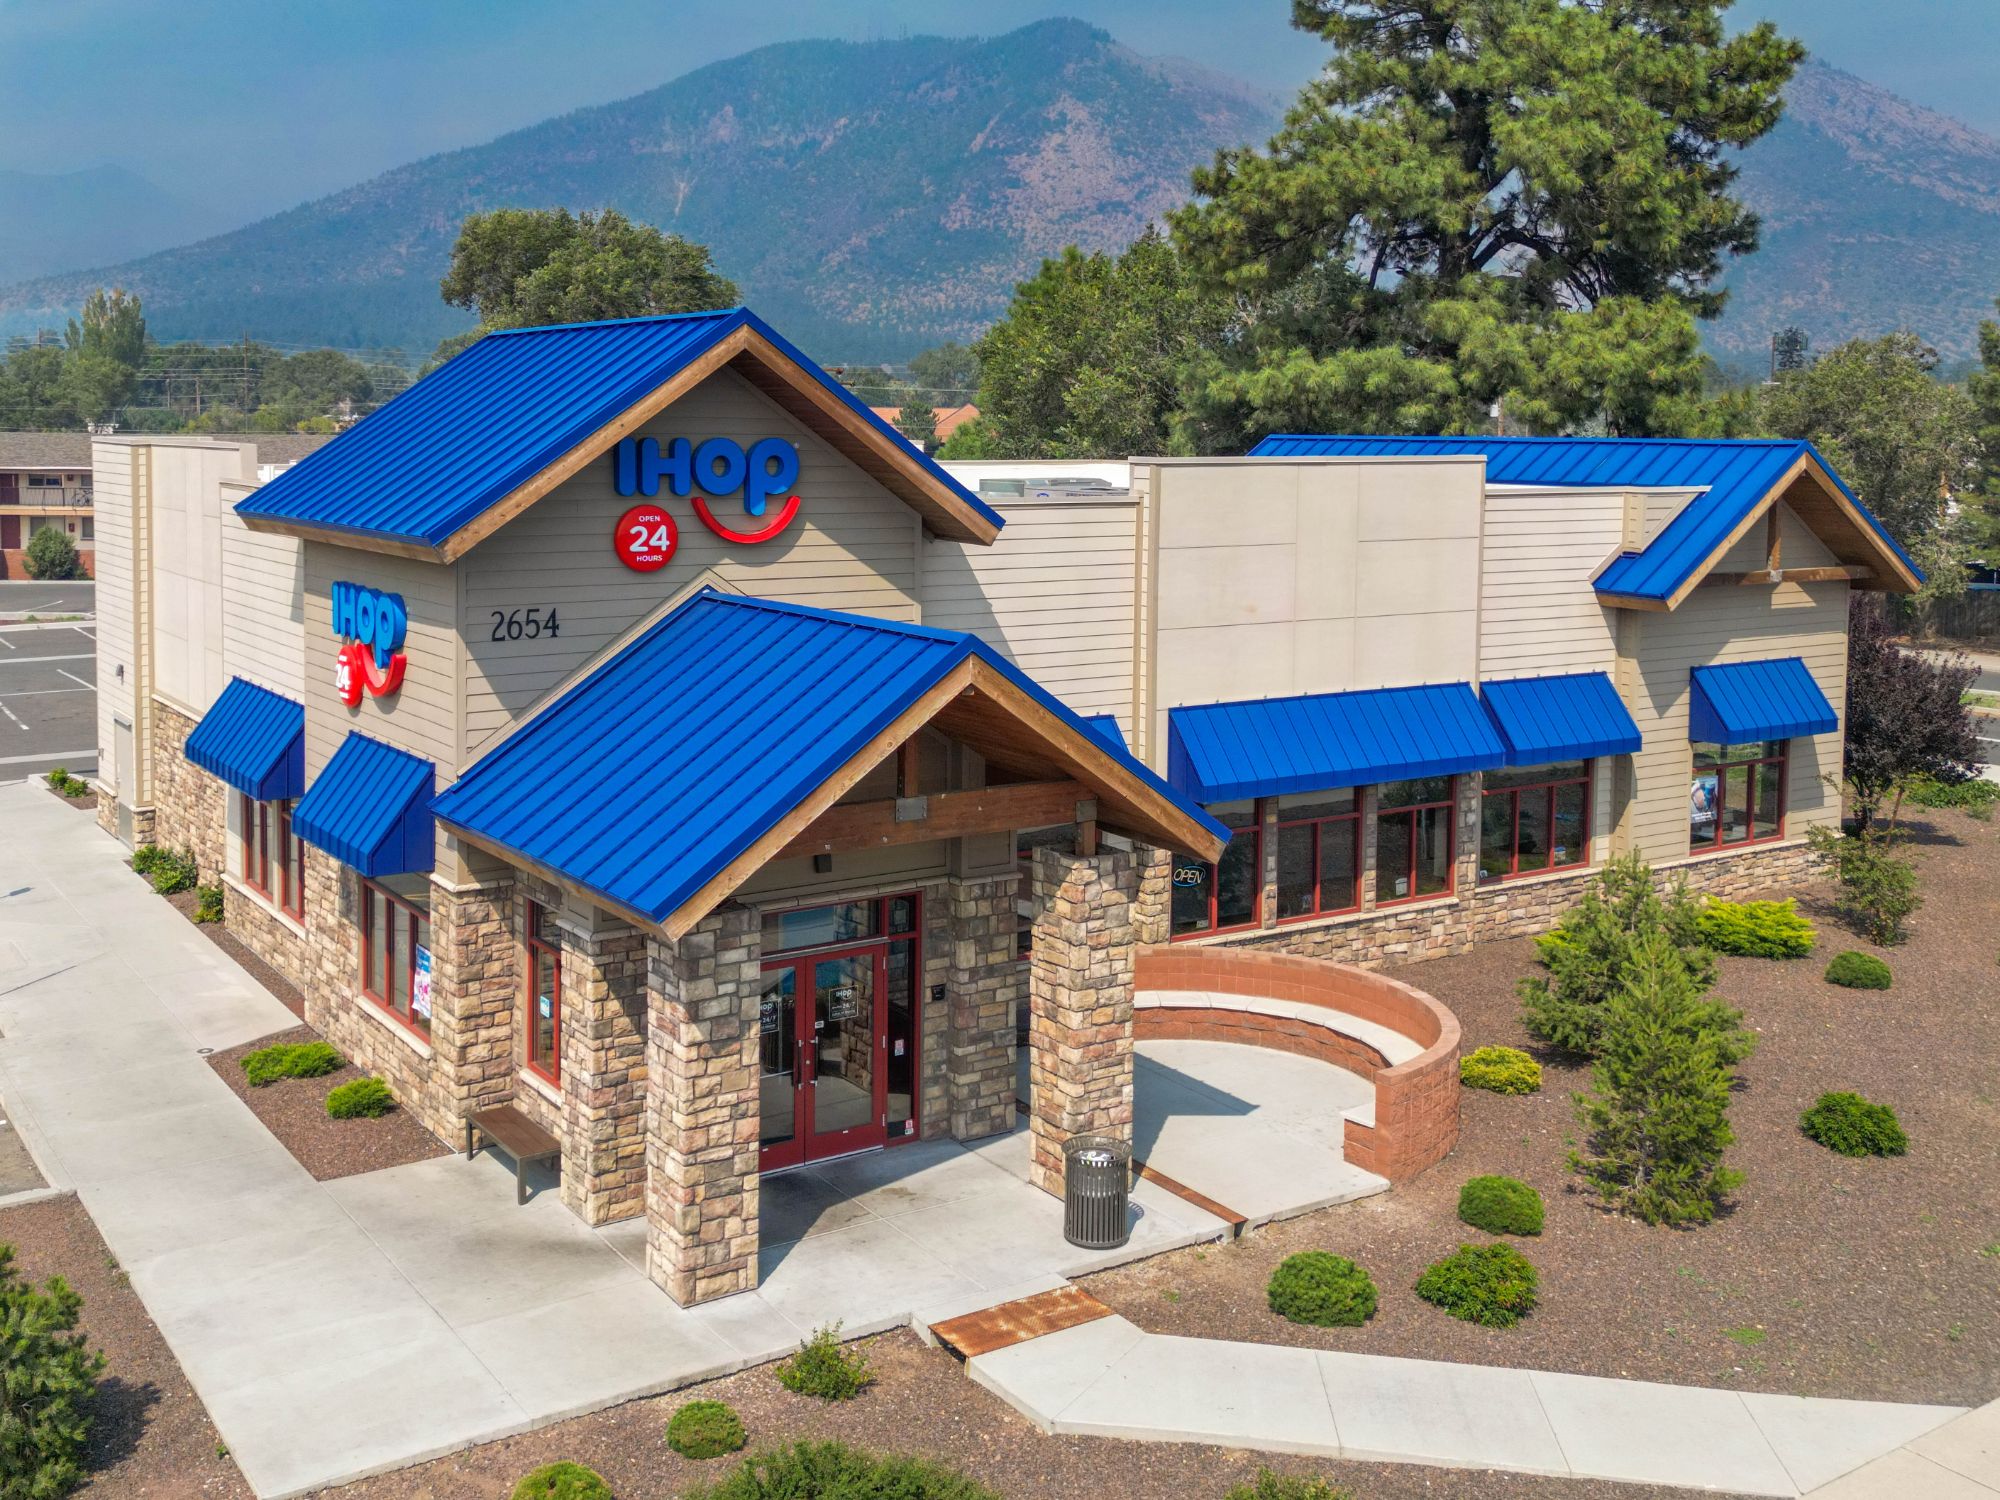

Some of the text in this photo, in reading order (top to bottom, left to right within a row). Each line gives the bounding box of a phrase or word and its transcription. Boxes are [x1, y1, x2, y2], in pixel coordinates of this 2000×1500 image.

[629, 525, 670, 552] 24
[491, 608, 559, 641] 2654
[1173, 868, 1203, 884] OPEN
